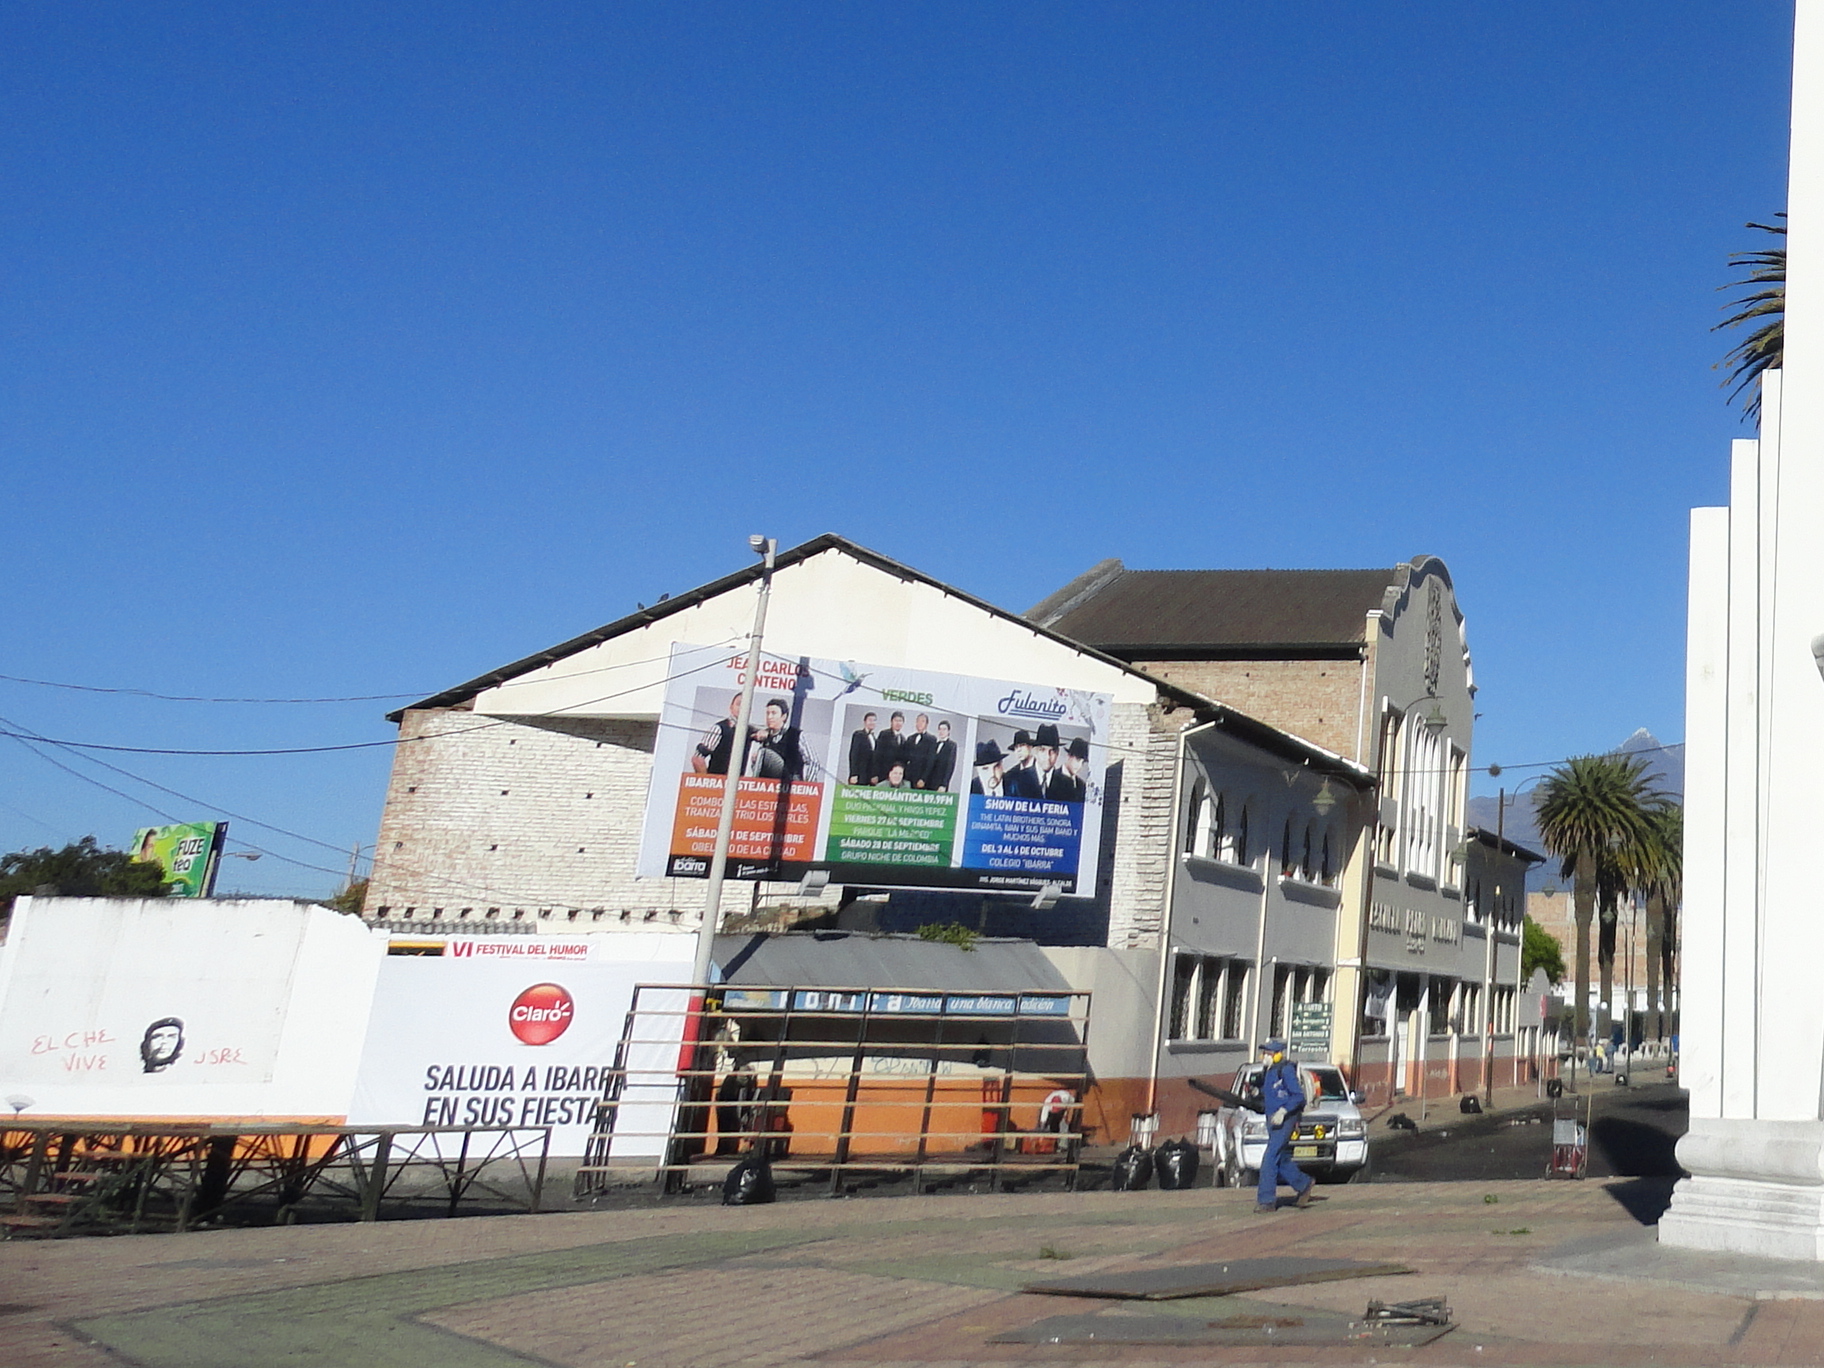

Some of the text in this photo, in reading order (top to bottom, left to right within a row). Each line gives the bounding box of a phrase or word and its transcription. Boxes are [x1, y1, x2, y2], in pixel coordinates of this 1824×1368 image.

[762, 661, 811, 678] CARLOS
[737, 673, 797, 691] CNTENO
[882, 689, 934, 706] VERDES
[998, 689, 1067, 715] Fulanito
[685, 776, 723, 789] IBARRA
[791, 784, 819, 796] REINA
[873, 789, 923, 802] ROMÁNTICA
[739, 799, 757, 810] LAS
[985, 798, 1070, 815] SHOW DE LA FERIA
[757, 811, 774, 822] LOS
[899, 817, 945, 828] SEPTIEMBRE
[736, 830, 748, 840] DE
[175, 838, 206, 857] FUZE
[736, 845, 748, 854] DE
[750, 846, 763, 855] LA
[840, 838, 871, 849] SÁBADO
[882, 840, 892, 849] DE
[894, 841, 940, 852] SEPTIEMBRE
[981, 843, 1064, 858] DEL 3 AL 6 DE OCTUBRE
[173, 857, 191, 872] tea
[841, 850, 868, 860] GRUPO
[891, 853, 902, 862] DE
[902, 854, 939, 864] COLOMBIA
[989, 858, 1021, 868] COLEGIO
[453, 942, 588, 958] VI FESTIVAL DEL HUMOR
[975, 996, 1013, 1010] blanca
[512, 1003, 564, 1022] Claro
[31, 1028, 116, 1055] EL CHE
[64, 1053, 107, 1072] VIVE
[424, 1065, 515, 1092] SALUDA
[520, 1066, 538, 1092] A
[423, 1096, 612, 1126] EN SUS FIESTA
